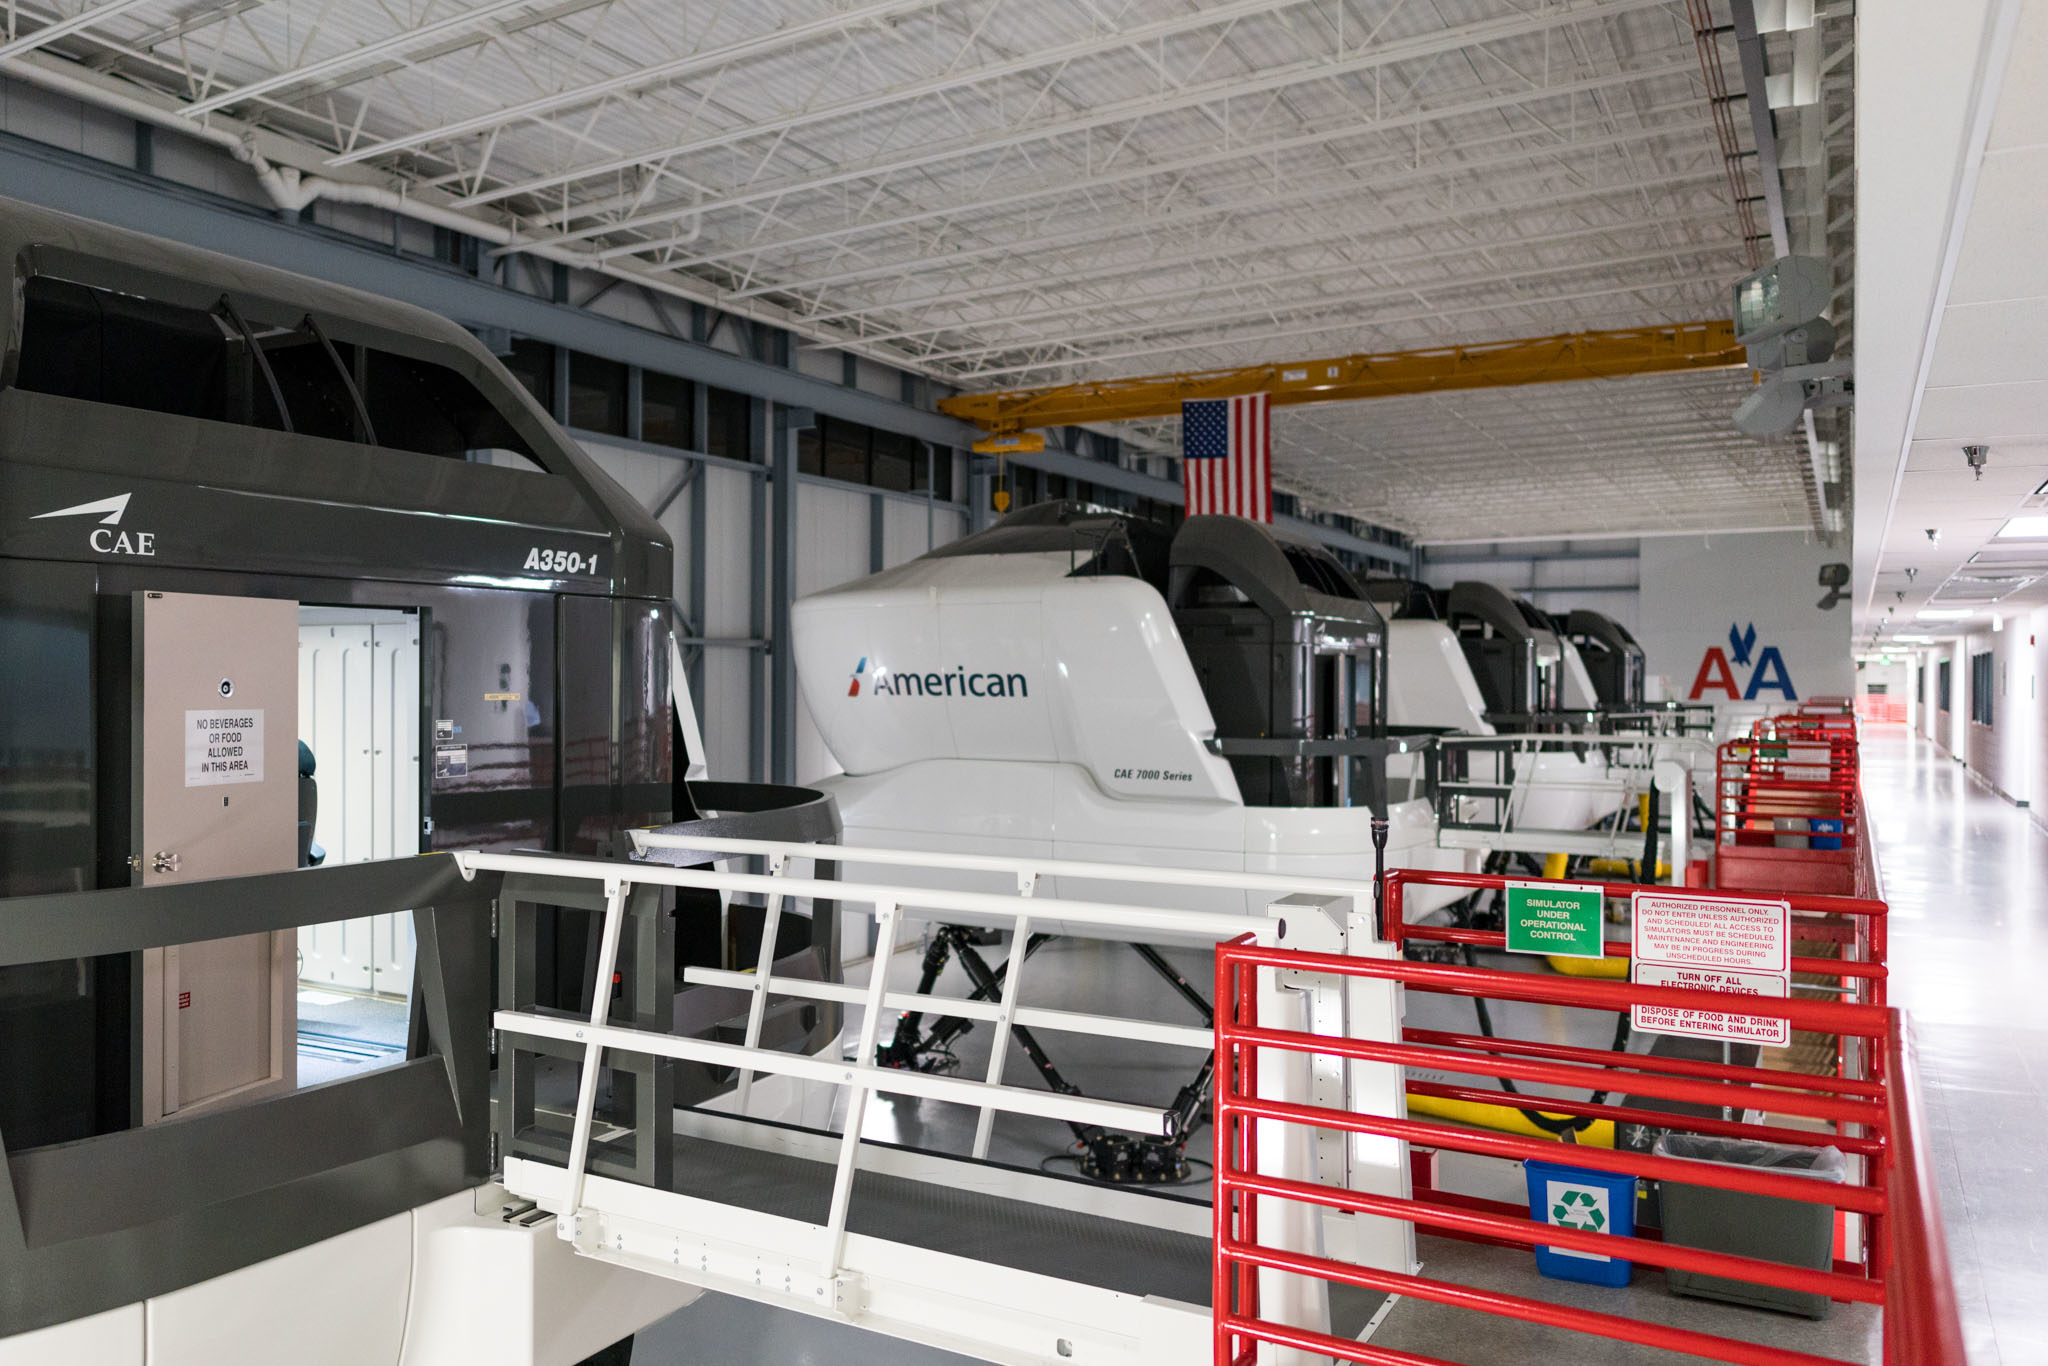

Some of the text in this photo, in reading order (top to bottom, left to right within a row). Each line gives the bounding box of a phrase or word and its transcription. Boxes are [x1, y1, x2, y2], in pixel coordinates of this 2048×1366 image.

[89, 528, 155, 556] CAE
[523, 547, 598, 575] A350-1
[873, 665, 1028, 697] American
[196, 717, 254, 730] NO BEVERAGES
[208, 732, 242, 744] OR FOOD
[207, 746, 243, 758] ALLOWED
[201, 760, 249, 773] IN THIS AREA
[1114, 768, 1193, 782] CAE 7000 Series
[1526, 899, 1580, 910] SIMULATOR
[1651, 901, 1699, 911] AUTHORIZED
[1700, 904, 1746, 914] PERSONNEL
[1536, 910, 1570, 920] UNDER
[1671, 911, 1697, 919] ENTER
[1698, 913, 1728, 921] UNLESS
[1730, 915, 1780, 925] AUTHORIZED
[1520, 919, 1587, 931] OPERATIONAL
[1643, 925, 1691, 935] SIMULATORS
[1692, 929, 1714, 937] MUST
[1647, 917, 1663, 925] AND
[1714, 922, 1728, 930] ALL
[1730, 923, 1761, 932] ACCESS
[1530, 930, 1577, 941] CONTROL
[1647, 934, 1701, 945] MAINTENANCE
[1720, 939, 1774, 950] ENGINEERING
[1665, 952, 1722, 963] UNSCHEDULED
[1692, 946, 1735, 956] PROGRESS
[1736, 950, 1767, 958] DURING
[1677, 972, 1742, 986] TURN OFF ALL
[1719, 985, 1759, 996] DEVICES
[1641, 1006, 1779, 1028] DISPOSE OF FOOD AND DRINK
[1640, 1015, 1780, 1038] BEFORE ENTERING SIMULATOR
